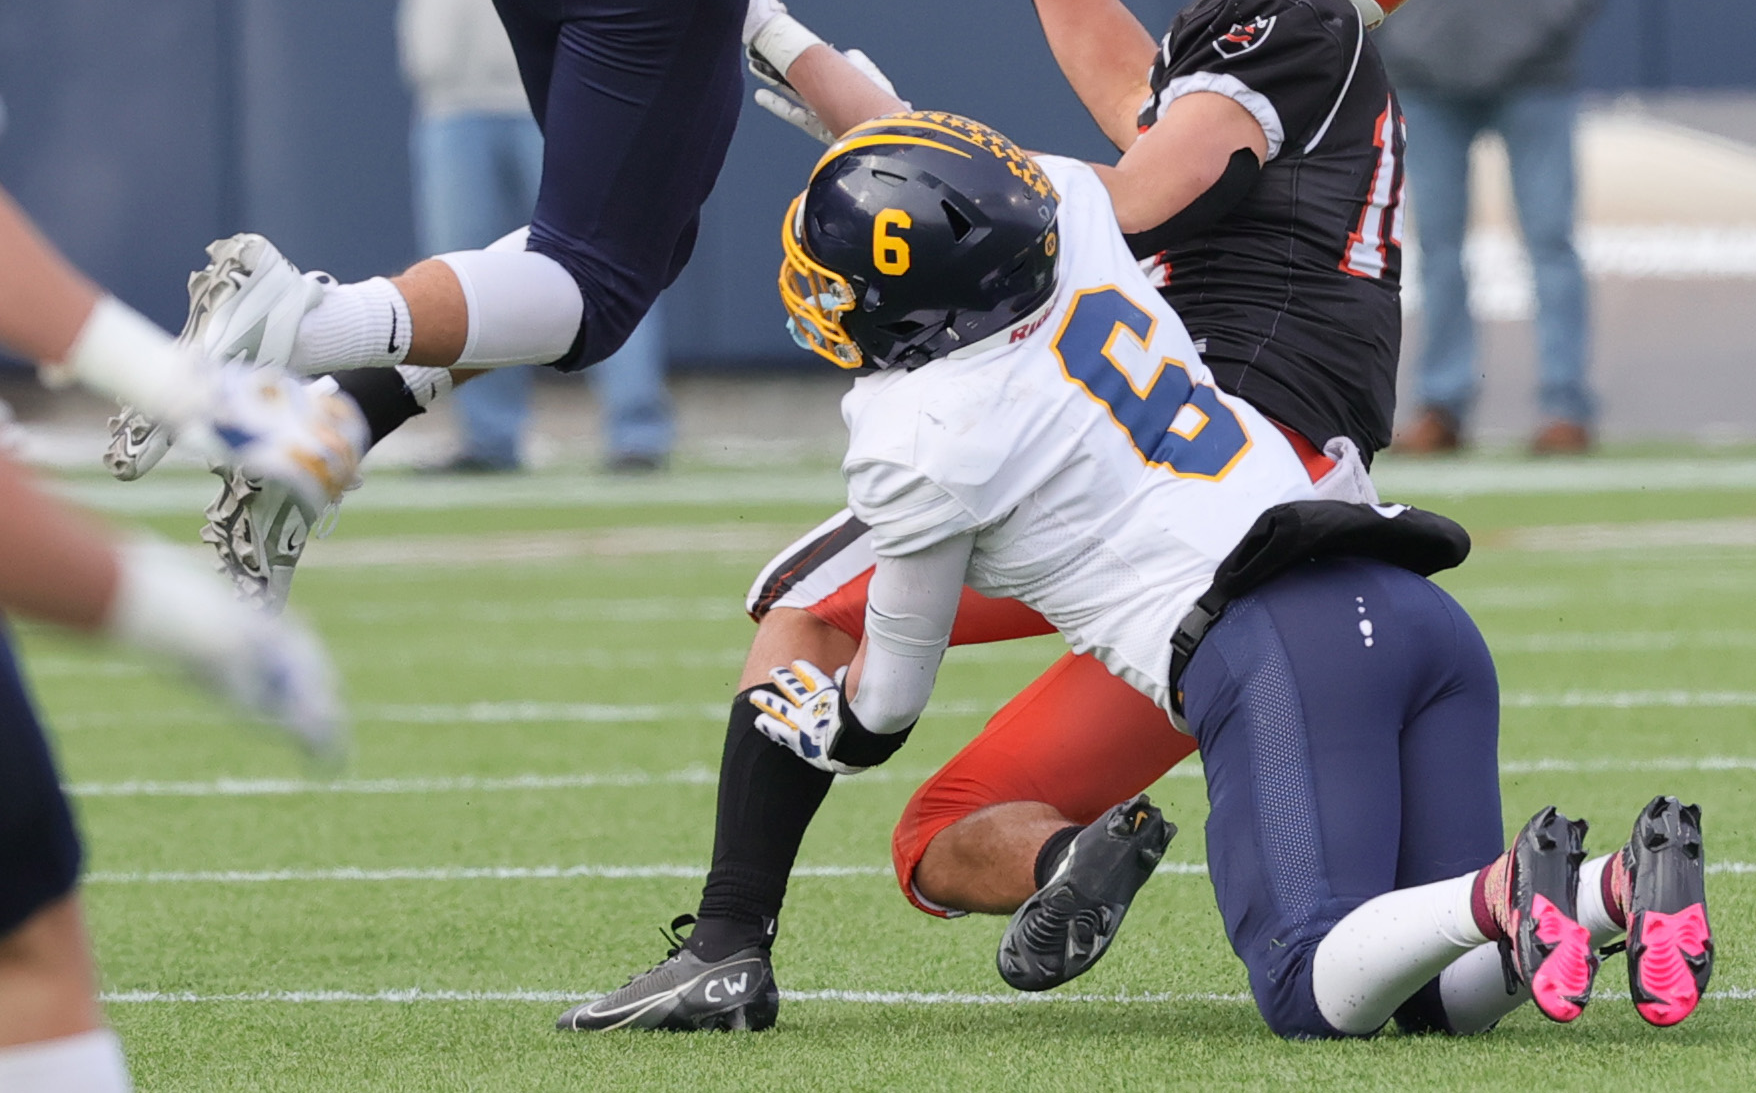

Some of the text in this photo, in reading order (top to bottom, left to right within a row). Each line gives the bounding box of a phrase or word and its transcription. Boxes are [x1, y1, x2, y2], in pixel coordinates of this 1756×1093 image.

[873, 208, 912, 276] 6
[1049, 283, 1254, 482] 6
[704, 972, 748, 1003] CW
